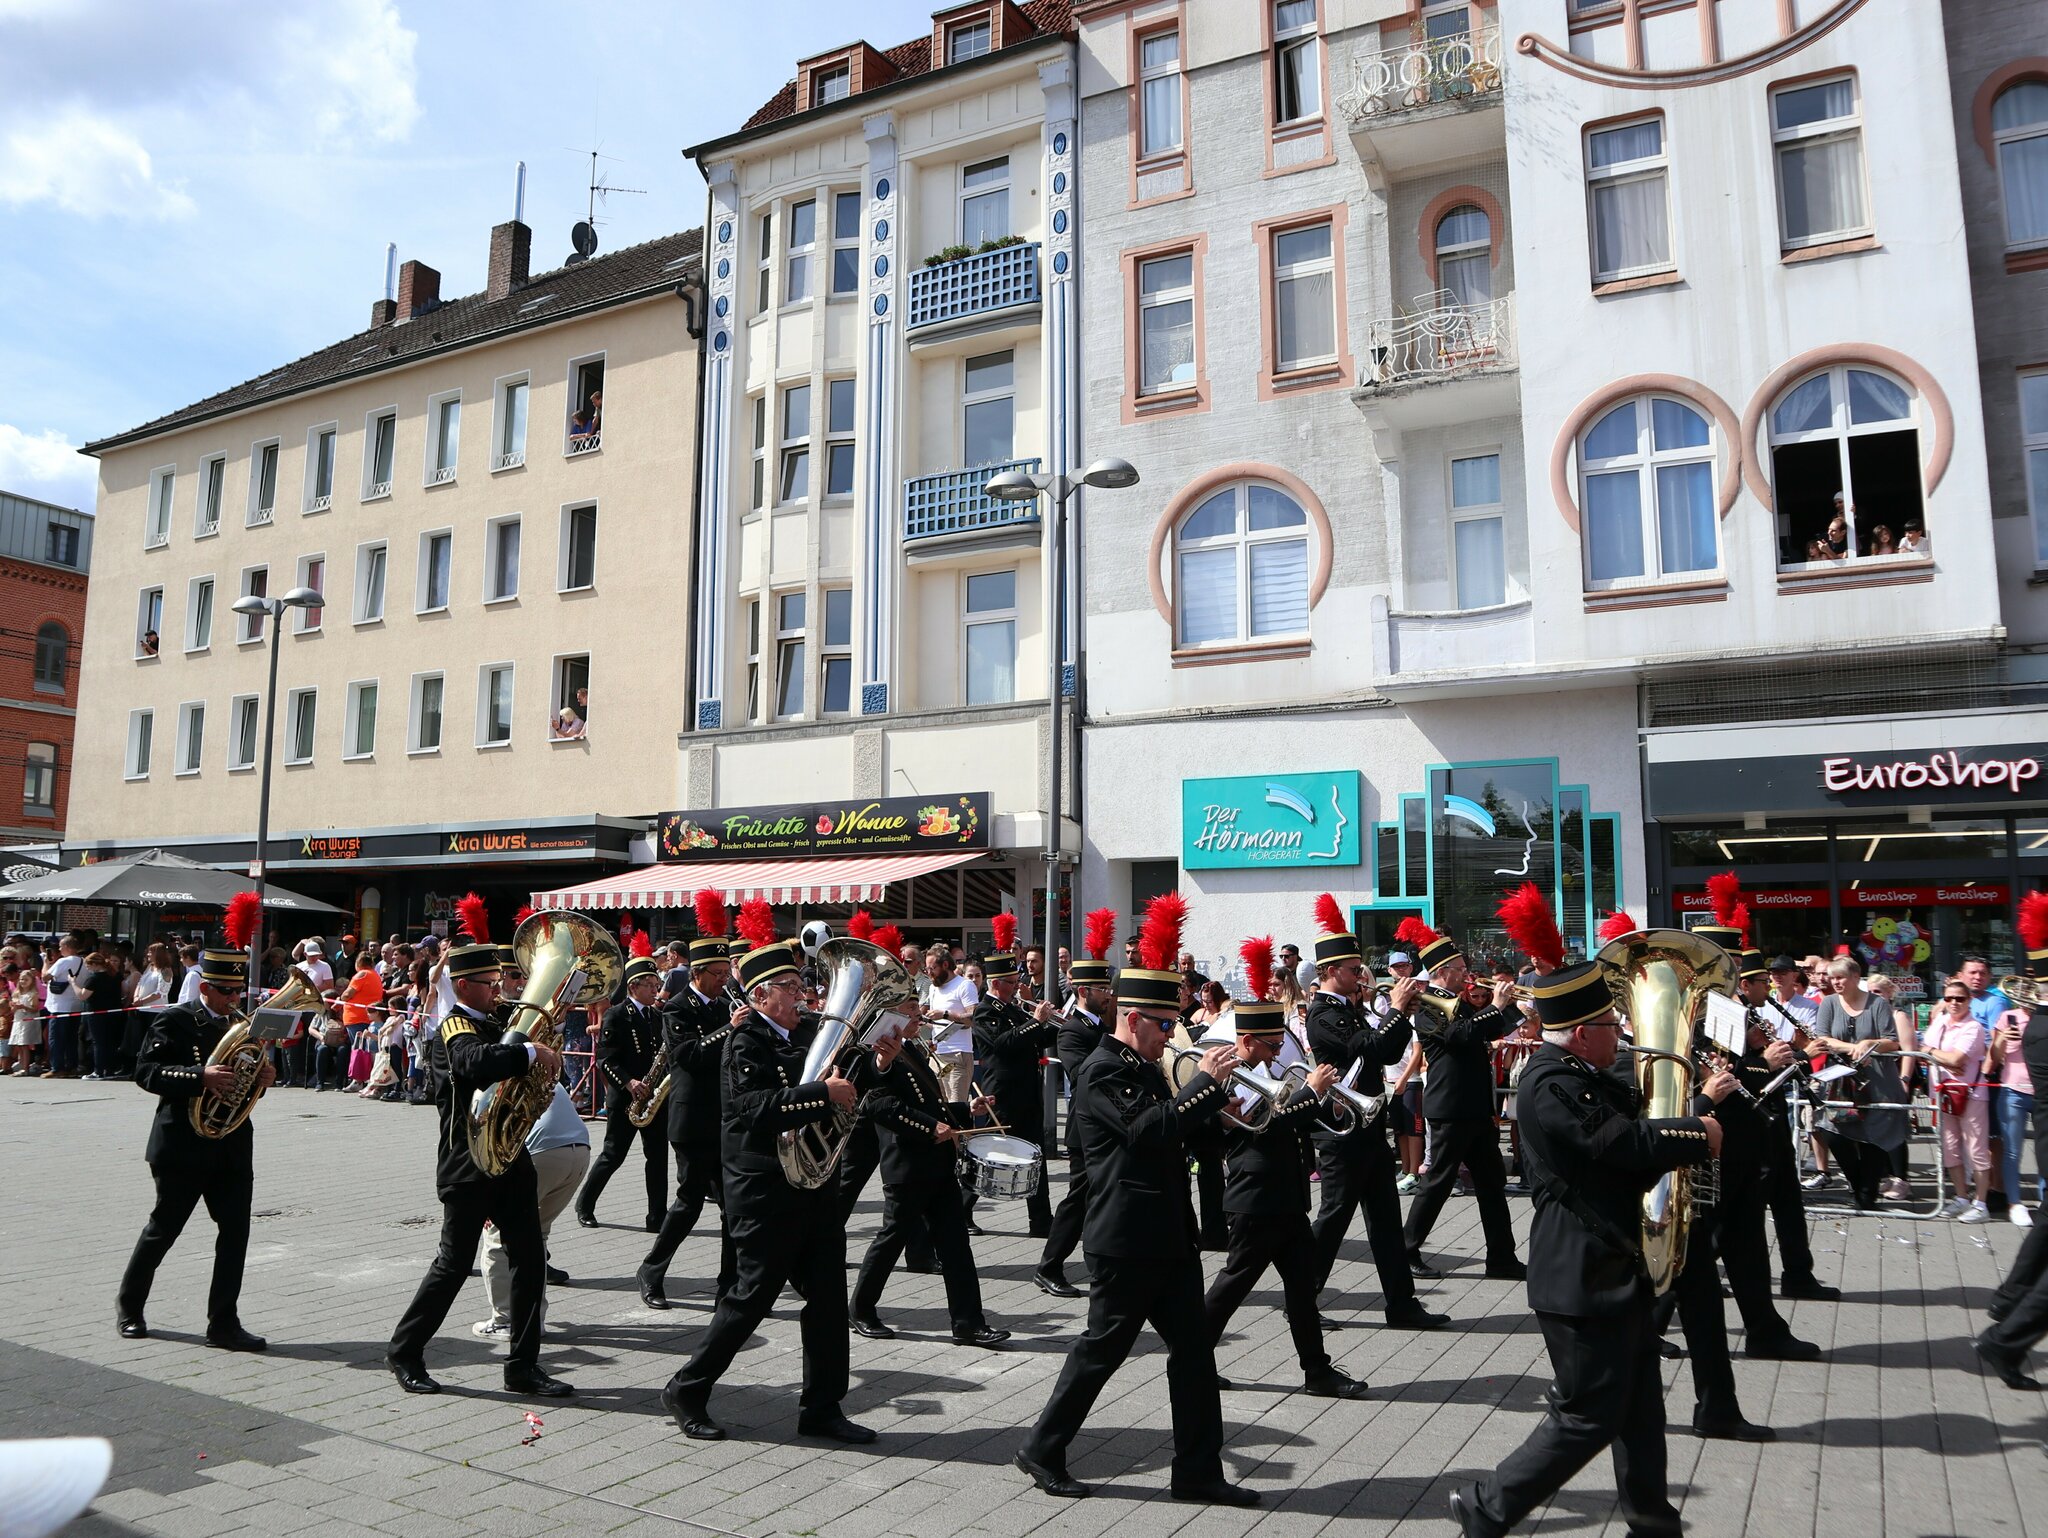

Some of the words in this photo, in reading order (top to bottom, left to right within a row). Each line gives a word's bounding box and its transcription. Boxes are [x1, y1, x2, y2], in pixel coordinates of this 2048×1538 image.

[1823, 750, 2040, 793] EuroShop
[1203, 804, 1241, 823] Der
[721, 814, 808, 841] Früchte
[301, 834, 327, 856] Xtra
[328, 836, 361, 851] Wurst
[448, 833, 480, 853] Xtra
[483, 832, 527, 851] Wurst
[721, 841, 742, 850] Frisches
[743, 841, 756, 849] Obst
[768, 840, 790, 848] Gemüse
[793, 839, 810, 849] frisch
[816, 839, 842, 848] gepresste
[874, 834, 912, 844] Gemüsesäfte
[1193, 822, 1303, 851] Hörmann
[322, 850, 357, 859] Lounge
[1247, 849, 1303, 861] HÖRGERÄTE
[1755, 893, 1813, 905] EuroShop
[1858, 890, 1918, 903] EuroShop
[1936, 888, 1999, 901] EuroShop
